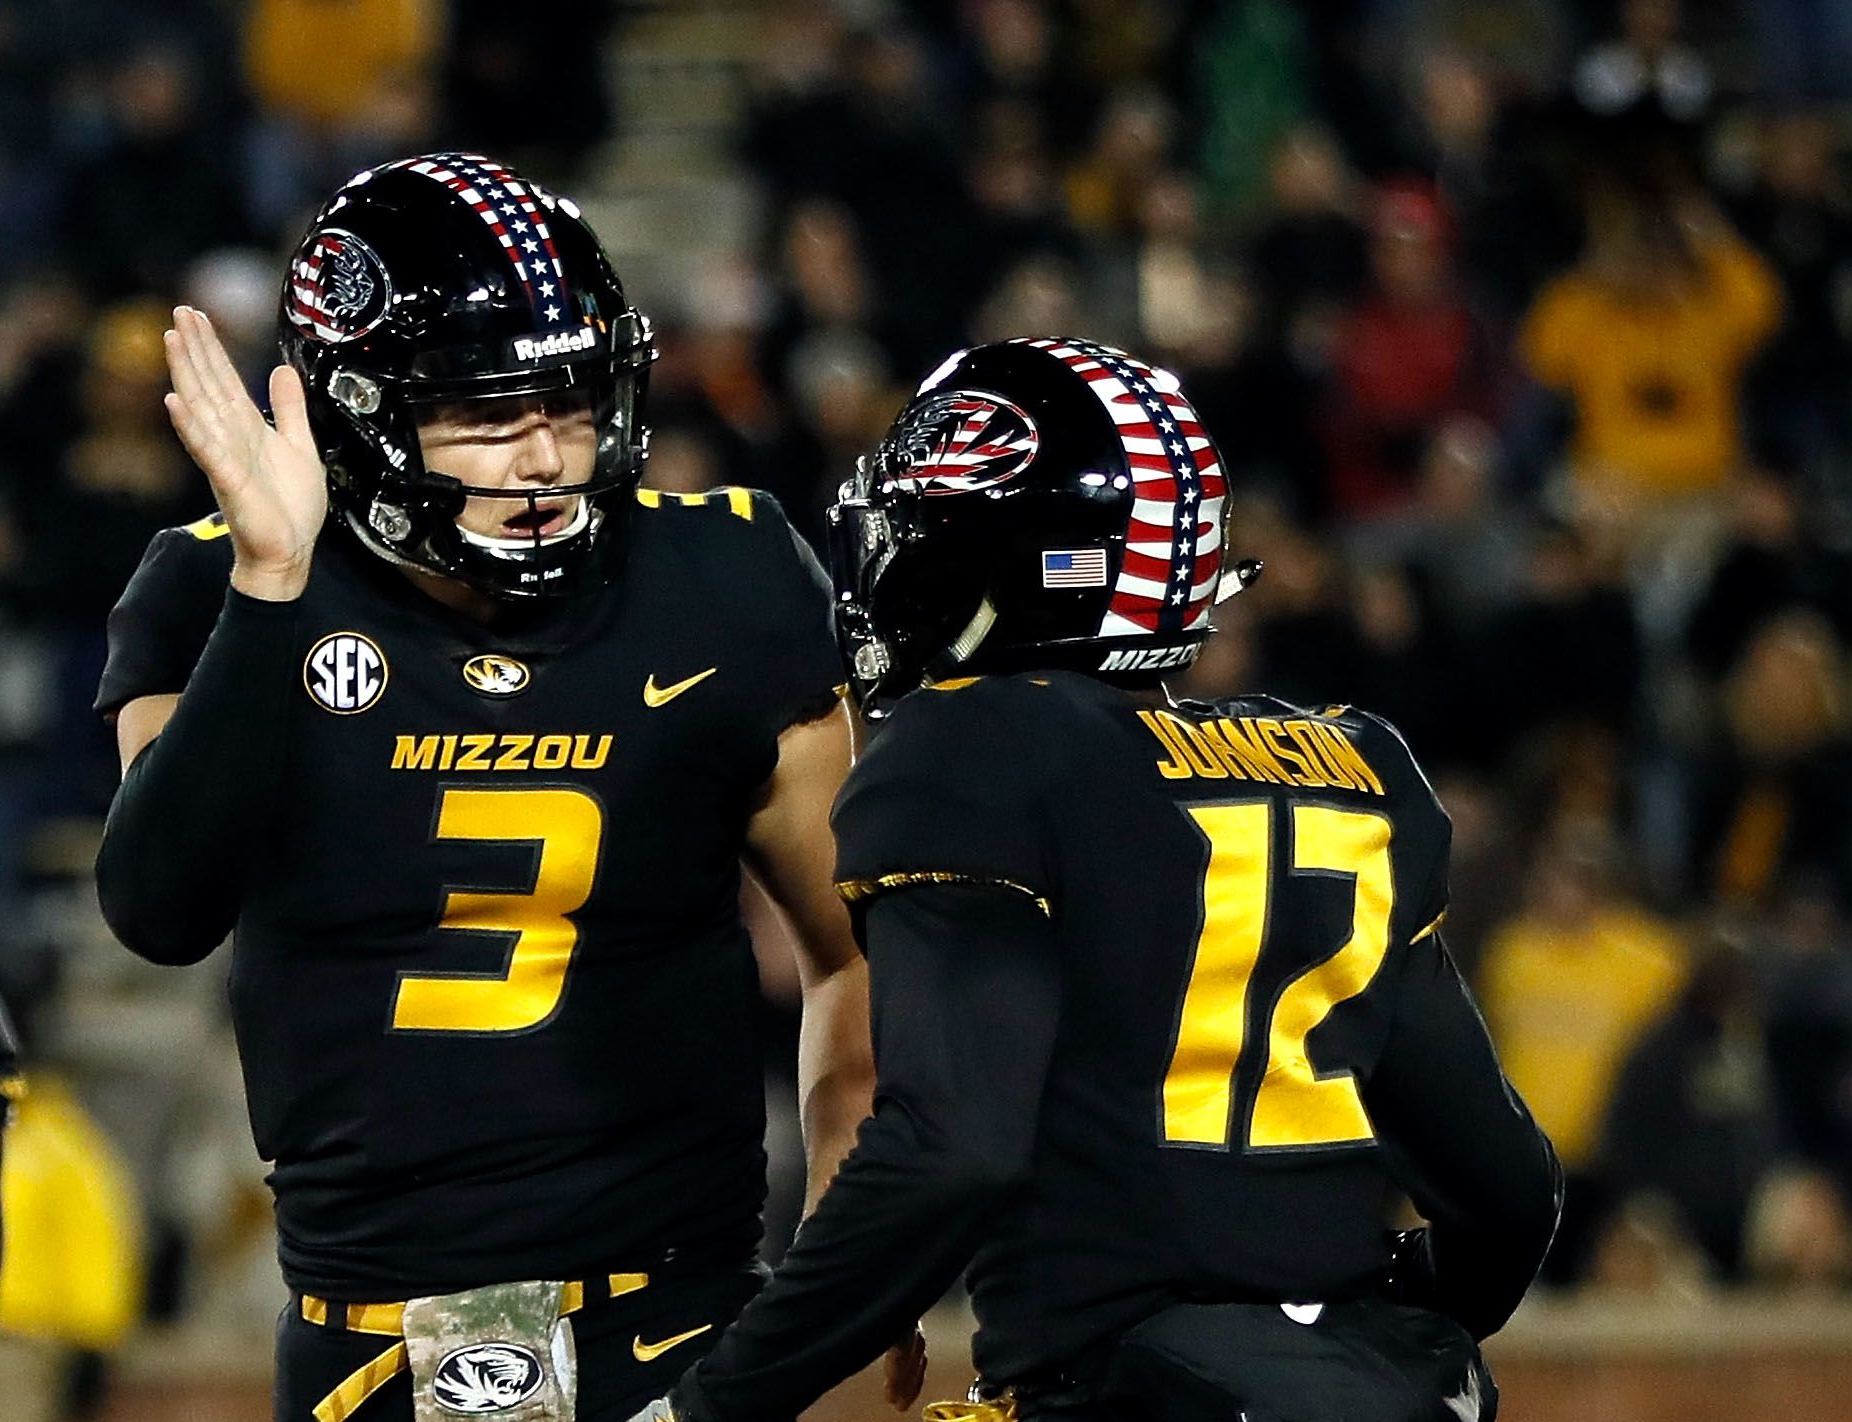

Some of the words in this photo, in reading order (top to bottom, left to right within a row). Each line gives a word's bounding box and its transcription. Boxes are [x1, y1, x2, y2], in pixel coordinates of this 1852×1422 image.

[514, 327, 596, 361] Riddell
[310, 637, 381, 708] SEC
[390, 734, 614, 771] MIZZOU
[1136, 709, 1386, 796] JOHNSON
[391, 789, 604, 1032] 3
[1162, 803, 1394, 1147] 12
